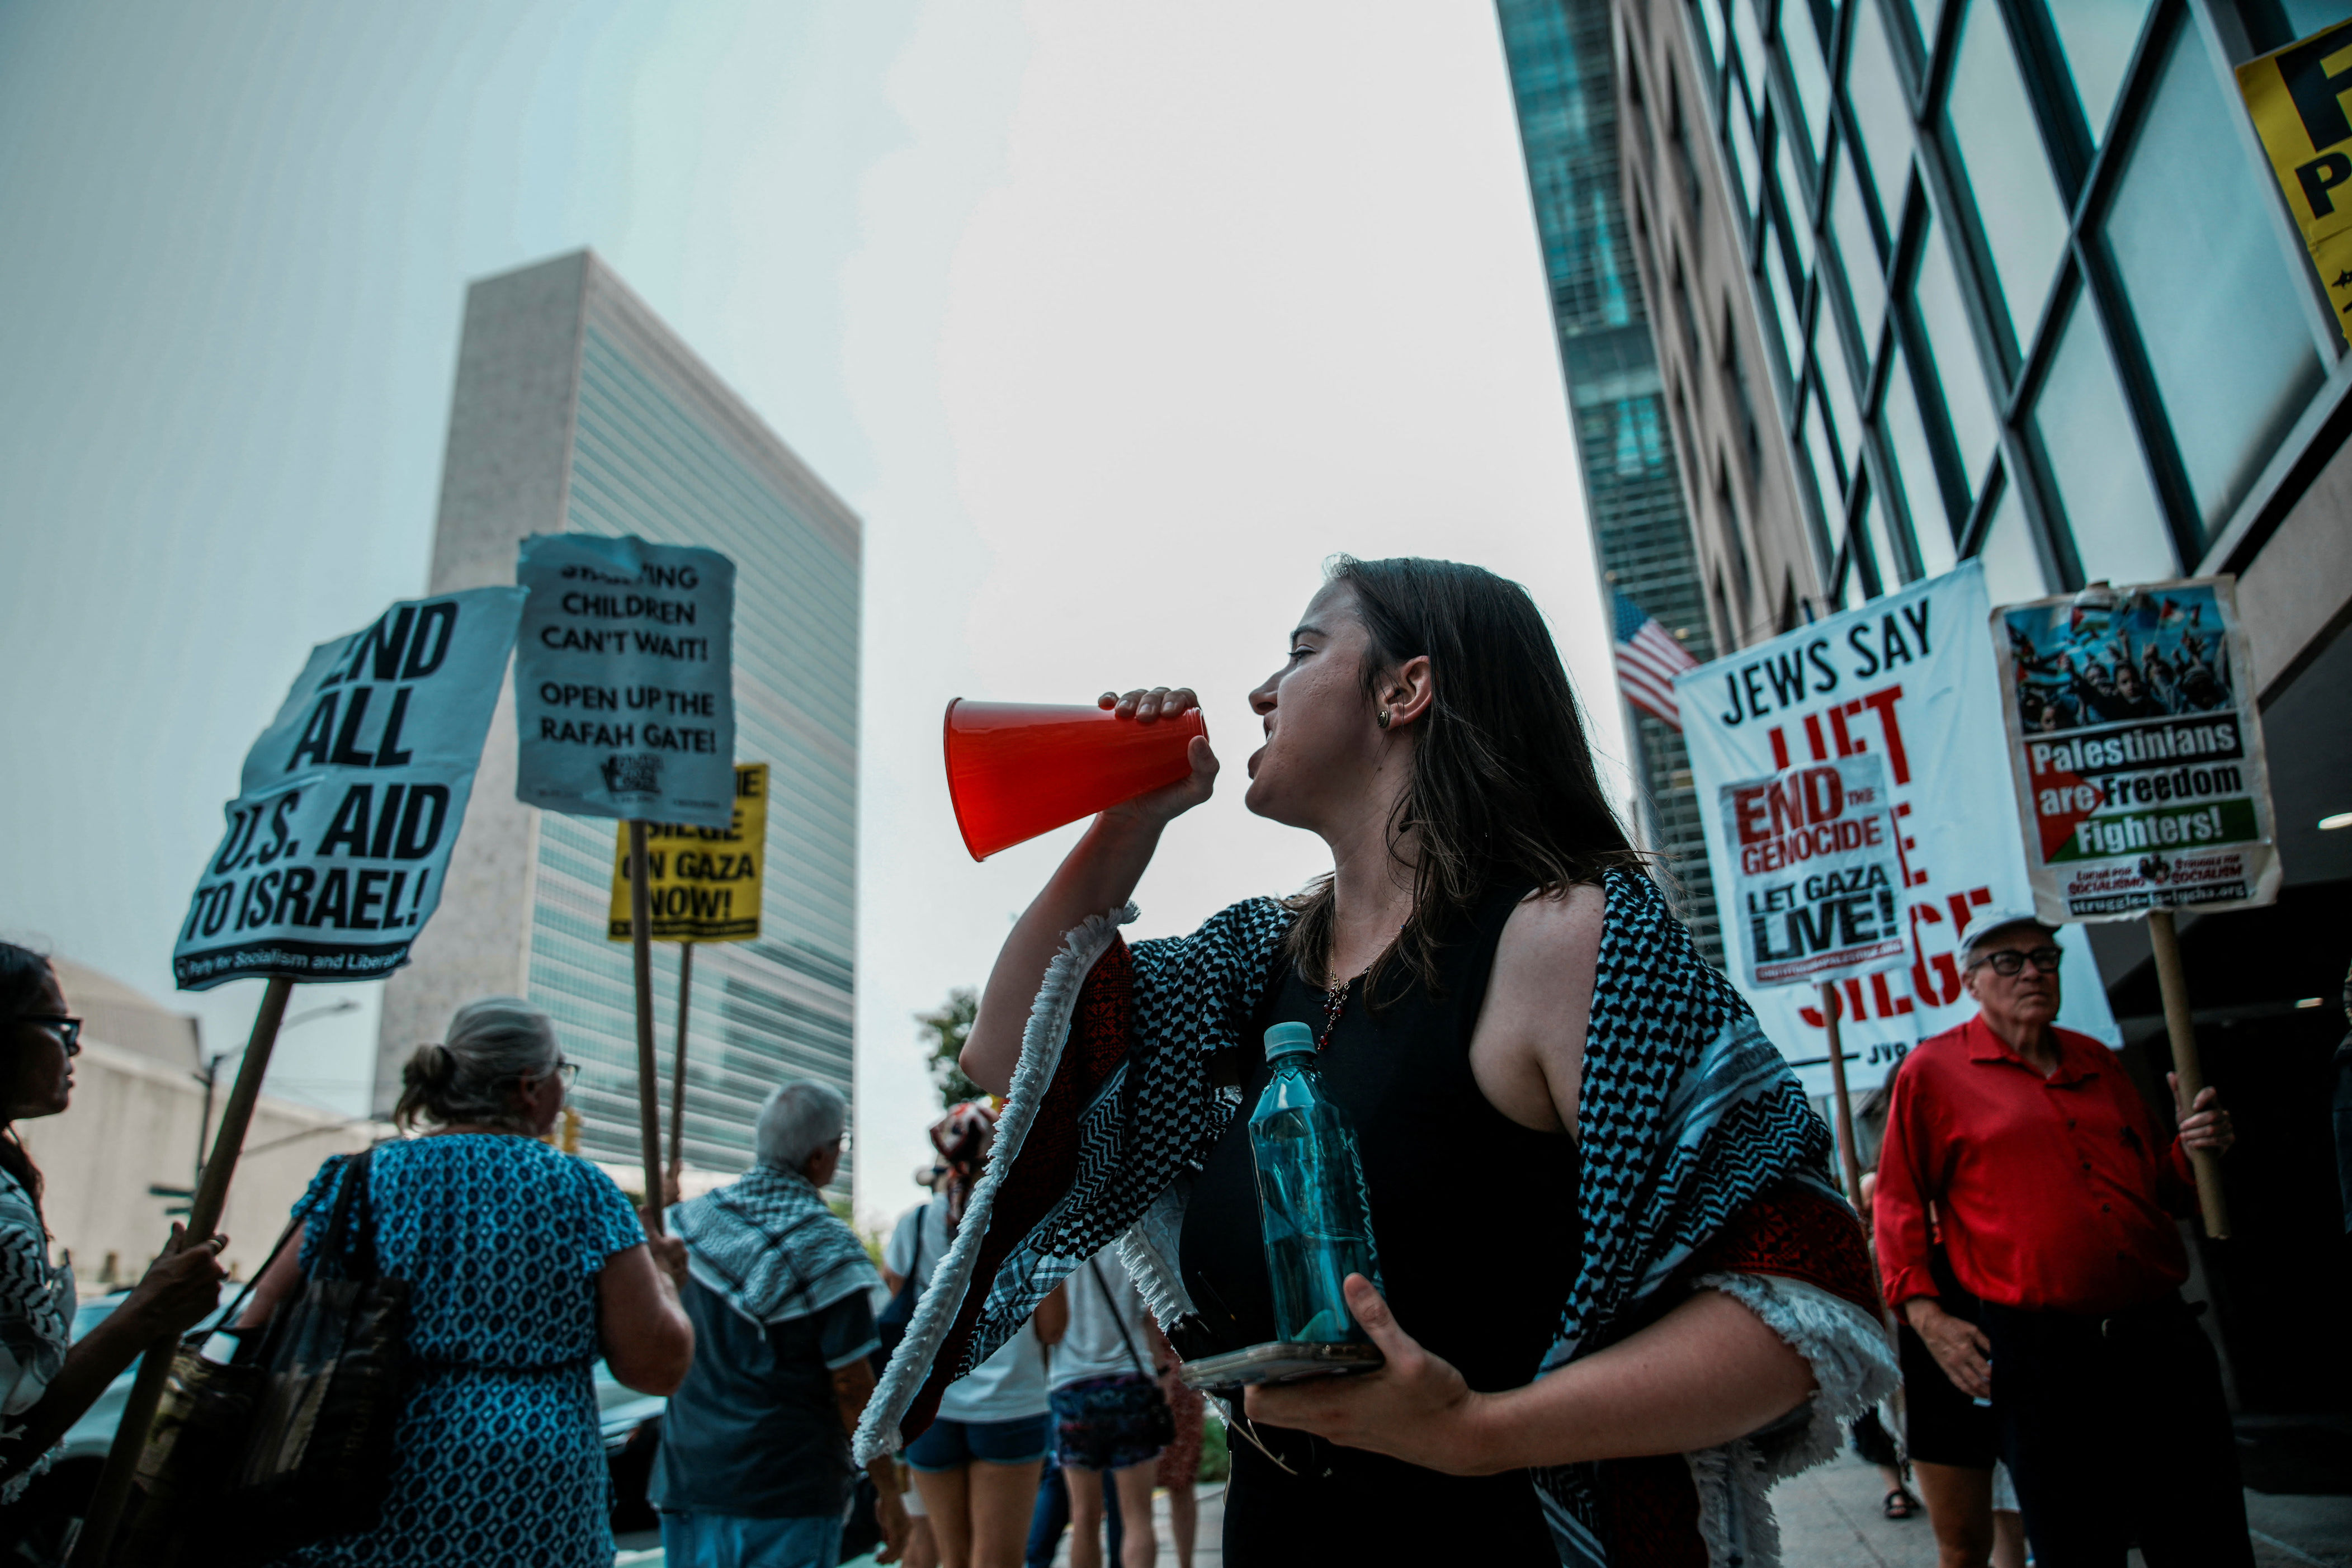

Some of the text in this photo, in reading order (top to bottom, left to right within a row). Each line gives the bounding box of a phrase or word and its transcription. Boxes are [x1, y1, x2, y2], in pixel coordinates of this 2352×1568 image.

[562, 592, 696, 625] CHILDREN
[541, 626, 708, 662] CAN'T WAIT!
[1722, 598, 1931, 725] JEWS SAY
[540, 682, 715, 716] OPEN UP THE
[285, 687, 413, 773] ALL
[540, 717, 716, 754] RAFAH GATE!
[2030, 722, 2236, 776] Palestinians
[1733, 766, 1875, 846] END THE
[2039, 764, 2244, 816] are Freedom
[214, 785, 450, 875] U.S. AID
[1741, 815, 1882, 876] GENOCIDE
[2075, 805, 2224, 854] Fighters!
[677, 851, 754, 882] GAZA
[1748, 863, 1889, 914] LET GAZA
[186, 867, 429, 941] TO ISRAEL!
[1751, 890, 1898, 963] LIVE!
[233, 948, 308, 969] Socialism
[311, 952, 346, 970] and
